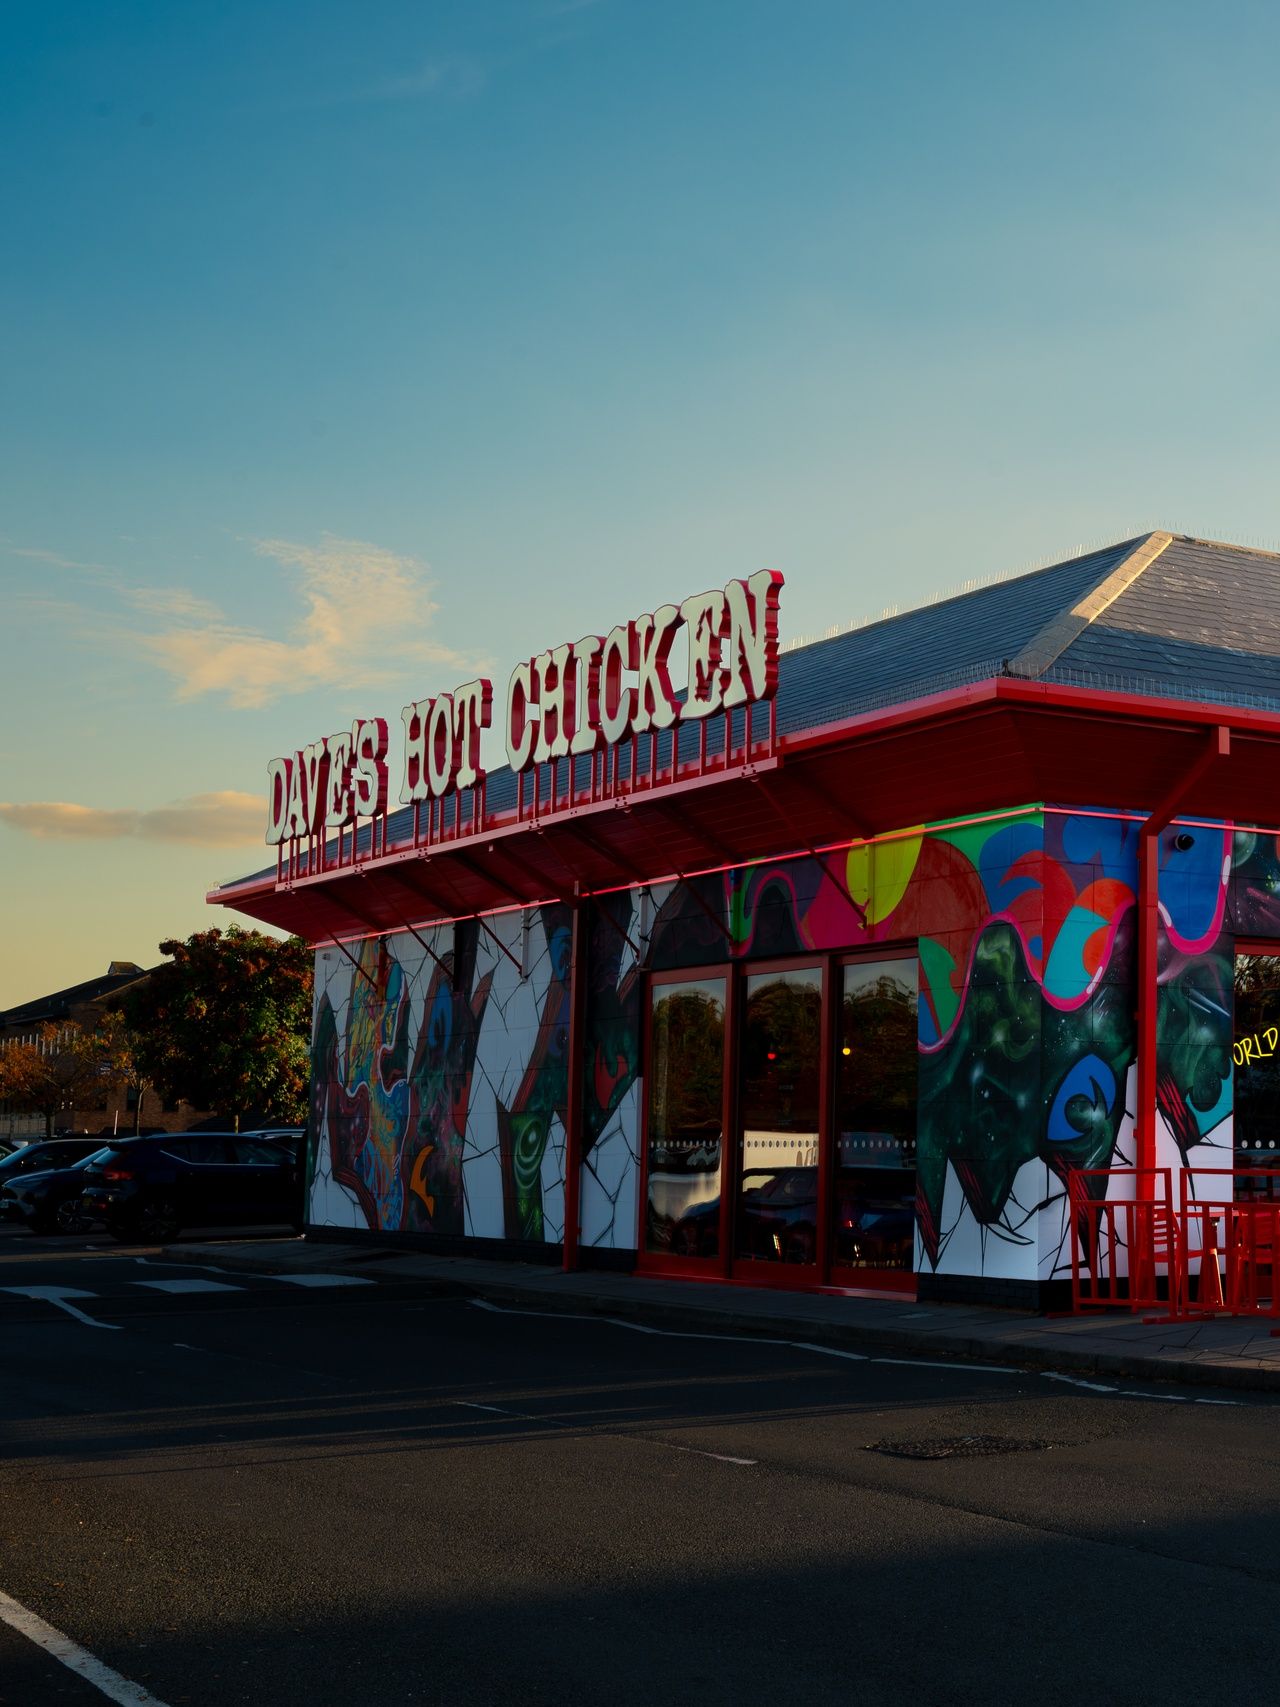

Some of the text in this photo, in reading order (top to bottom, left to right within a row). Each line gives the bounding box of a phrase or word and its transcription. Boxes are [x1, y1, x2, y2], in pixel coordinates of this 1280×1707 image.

[266, 569, 784, 845] DAVE'S HOT CHICKEN
